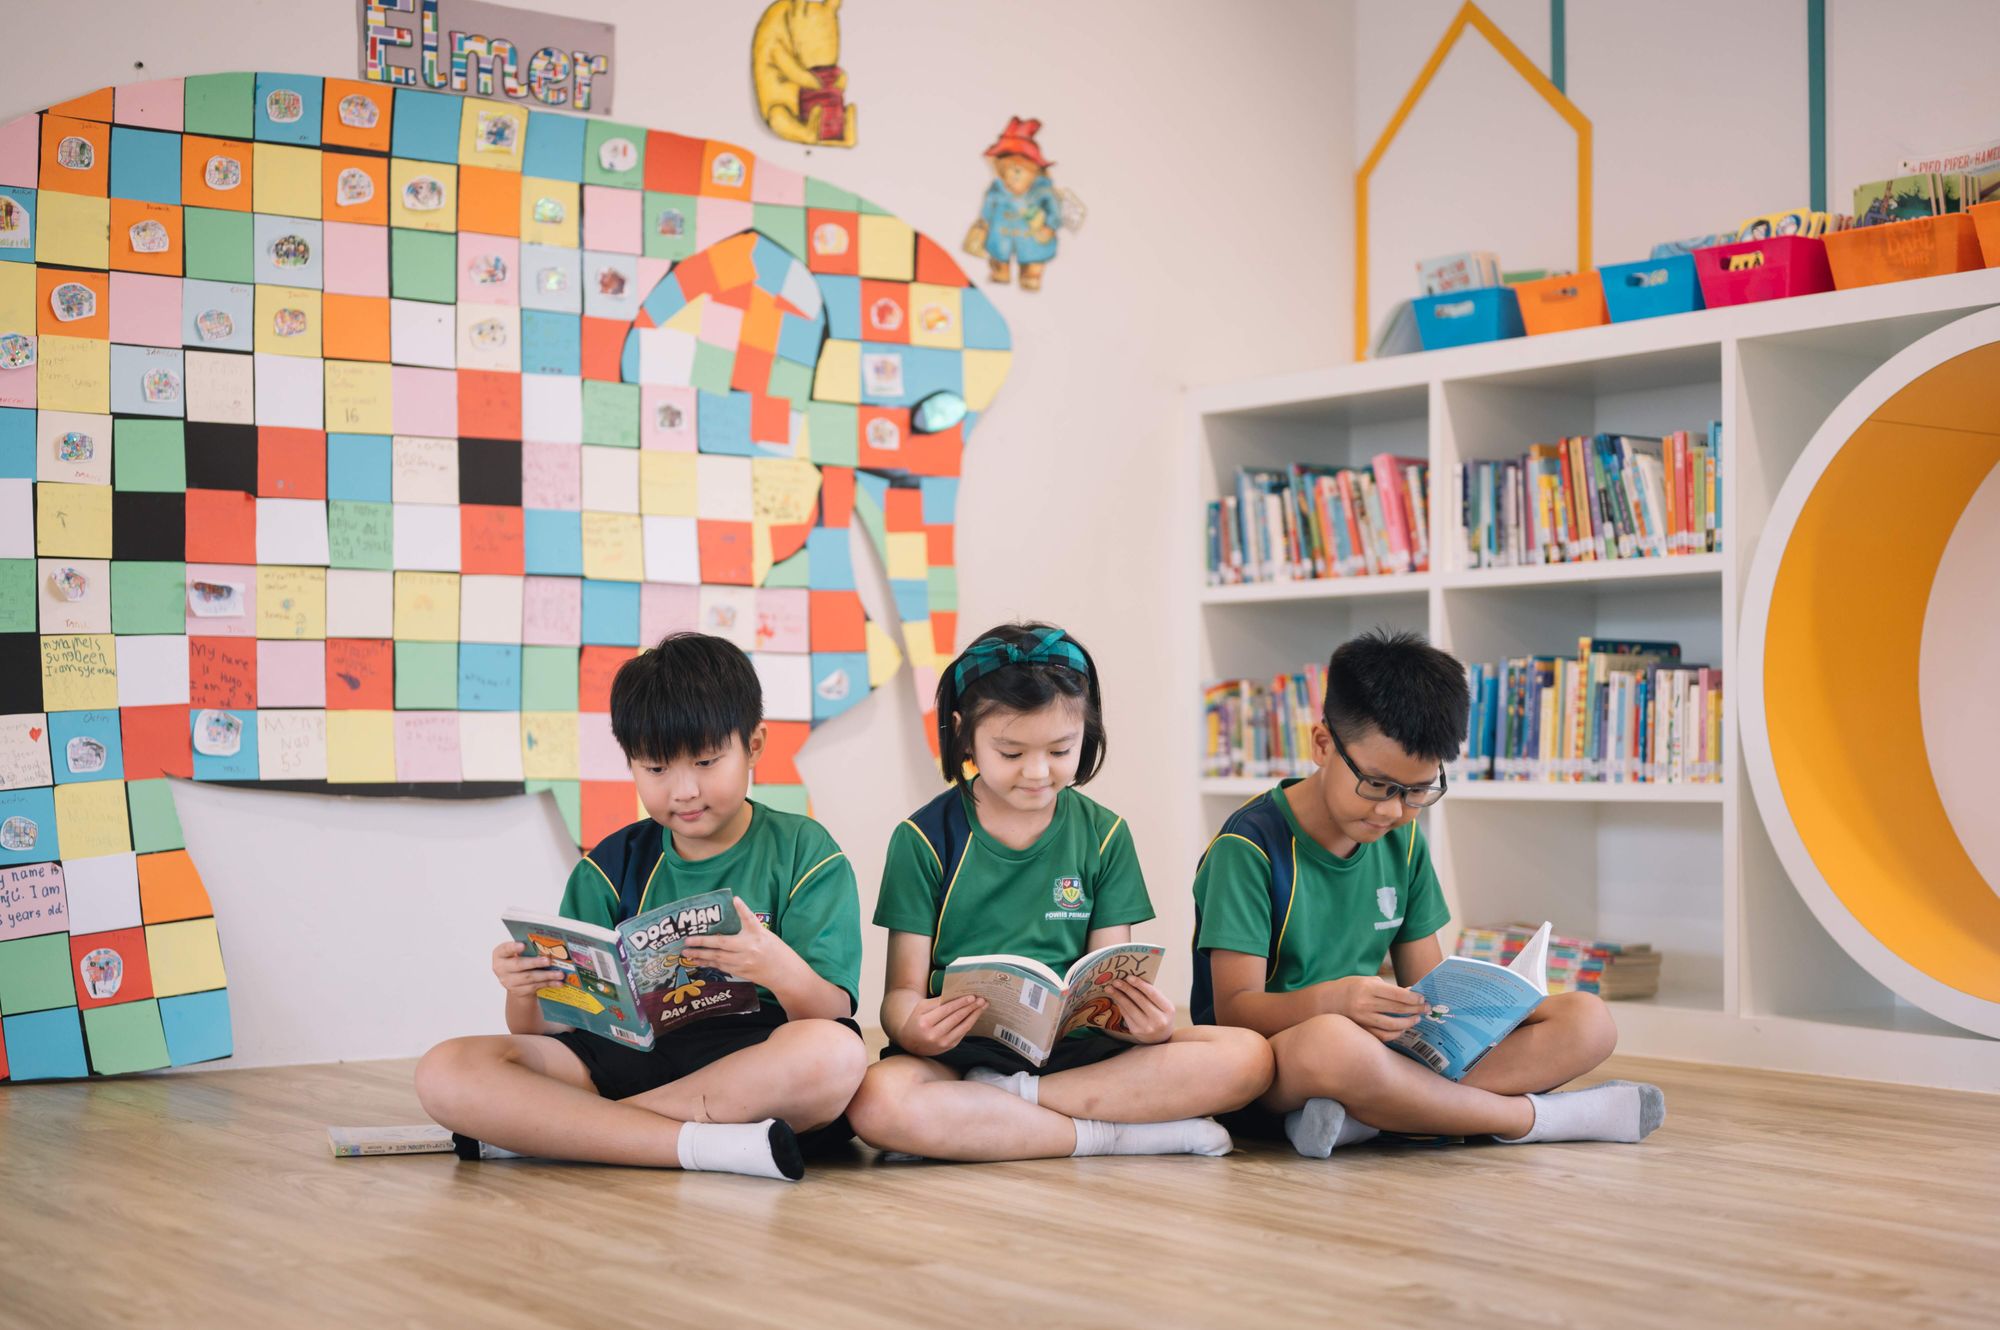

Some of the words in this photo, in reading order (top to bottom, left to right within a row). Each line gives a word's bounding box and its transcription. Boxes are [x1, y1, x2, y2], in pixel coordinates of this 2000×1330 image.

[366, 0, 607, 110] Elmer
[11, 866, 46, 882] name
[41, 885, 61, 898] am
[8, 909, 42, 929] years
[628, 917, 676, 951] DOG
[677, 904, 722, 930] MAN
[661, 1005, 688, 1021] DAV
